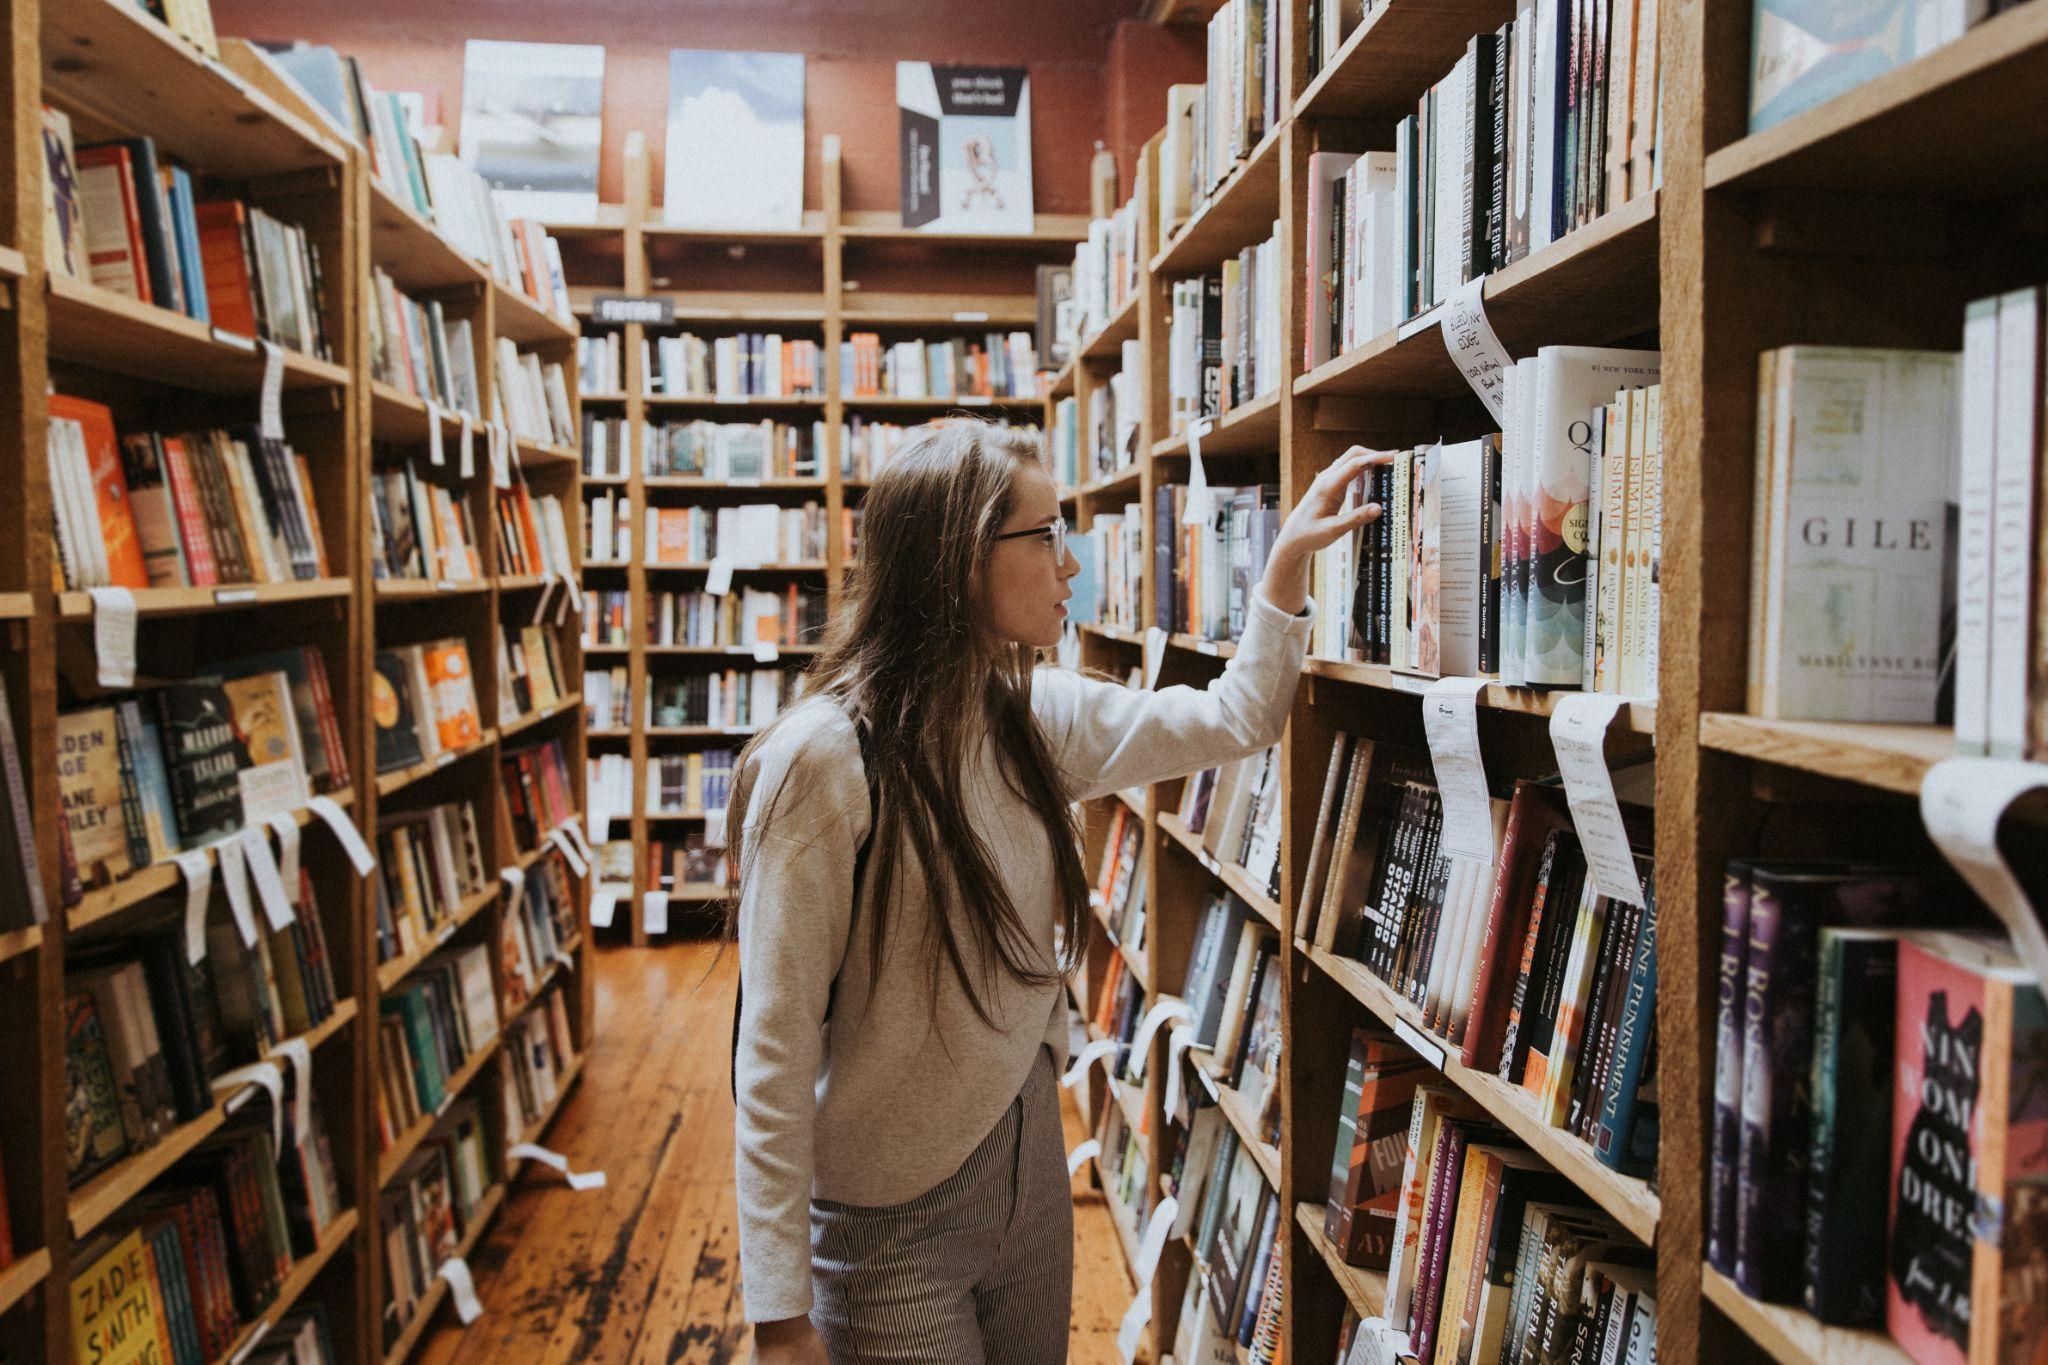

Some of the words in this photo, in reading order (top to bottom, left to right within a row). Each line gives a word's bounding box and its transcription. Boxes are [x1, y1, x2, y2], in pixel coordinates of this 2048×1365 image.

[1494, 36, 1504, 92] THOMAS
[1464, 107, 1474, 169] PYNCHON
[1493, 93, 1504, 155] PYNCHON
[1462, 172, 1473, 232] BLEEDING
[1492, 162, 1502, 222] BLEEDING
[1461, 235, 1472, 267] EDGE
[1490, 226, 1501, 259] EDGE
[1610, 455, 1623, 529] ISHMAEL
[1627, 456, 1640, 531] ISHMAEL
[1642, 453, 1655, 530] ISHMAEL
[1586, 604, 1594, 658] Quindlen
[1407, 829, 1423, 892] IMPERFECTIONISTS
[1415, 830, 1432, 895] IMPERFECTIONISTS
[1421, 834, 1437, 898] IMPERFECTIONISTS
[1382, 866, 1403, 943] OTARED
[1390, 870, 1411, 948] OTARED
[1622, 910, 1630, 931] WHY
[1630, 914, 1639, 936] WHY
[1604, 920, 1616, 956] RAKHA
[1616, 942, 1624, 967] CAME
[1624, 946, 1632, 971] CAME
[1719, 952, 1738, 1043] ROSE
[1744, 966, 1769, 1056] ROSE
[1583, 998, 1600, 1066] CROCODILES
[1600, 1021, 1608, 1048] MARY
[1606, 982, 1644, 1119] PUNISHMENT
[1608, 1026, 1616, 1054] MARY
[1438, 1154, 1454, 1229] UNRESTORED
[1420, 1223, 1430, 1268] WOMAN
[1472, 1238, 1484, 1266] RASH
[1477, 1214, 1489, 1237] RON
[1430, 1233, 1441, 1279] WOMAN
[1540, 1242, 1552, 1276] THE
[1554, 1256, 1567, 1296] THE
[80, 1248, 143, 1324] ZADIE
[1464, 1268, 1480, 1312] READER
[1528, 1282, 1544, 1337] RISEN
[1612, 1294, 1624, 1320] THE
[88, 1287, 150, 1365] SMITH
[1542, 1297, 1558, 1352] RISEN
[1598, 1304, 1606, 1328] RON
[1604, 1319, 1620, 1362] WORLD
[1592, 1331, 1601, 1362] RASH
